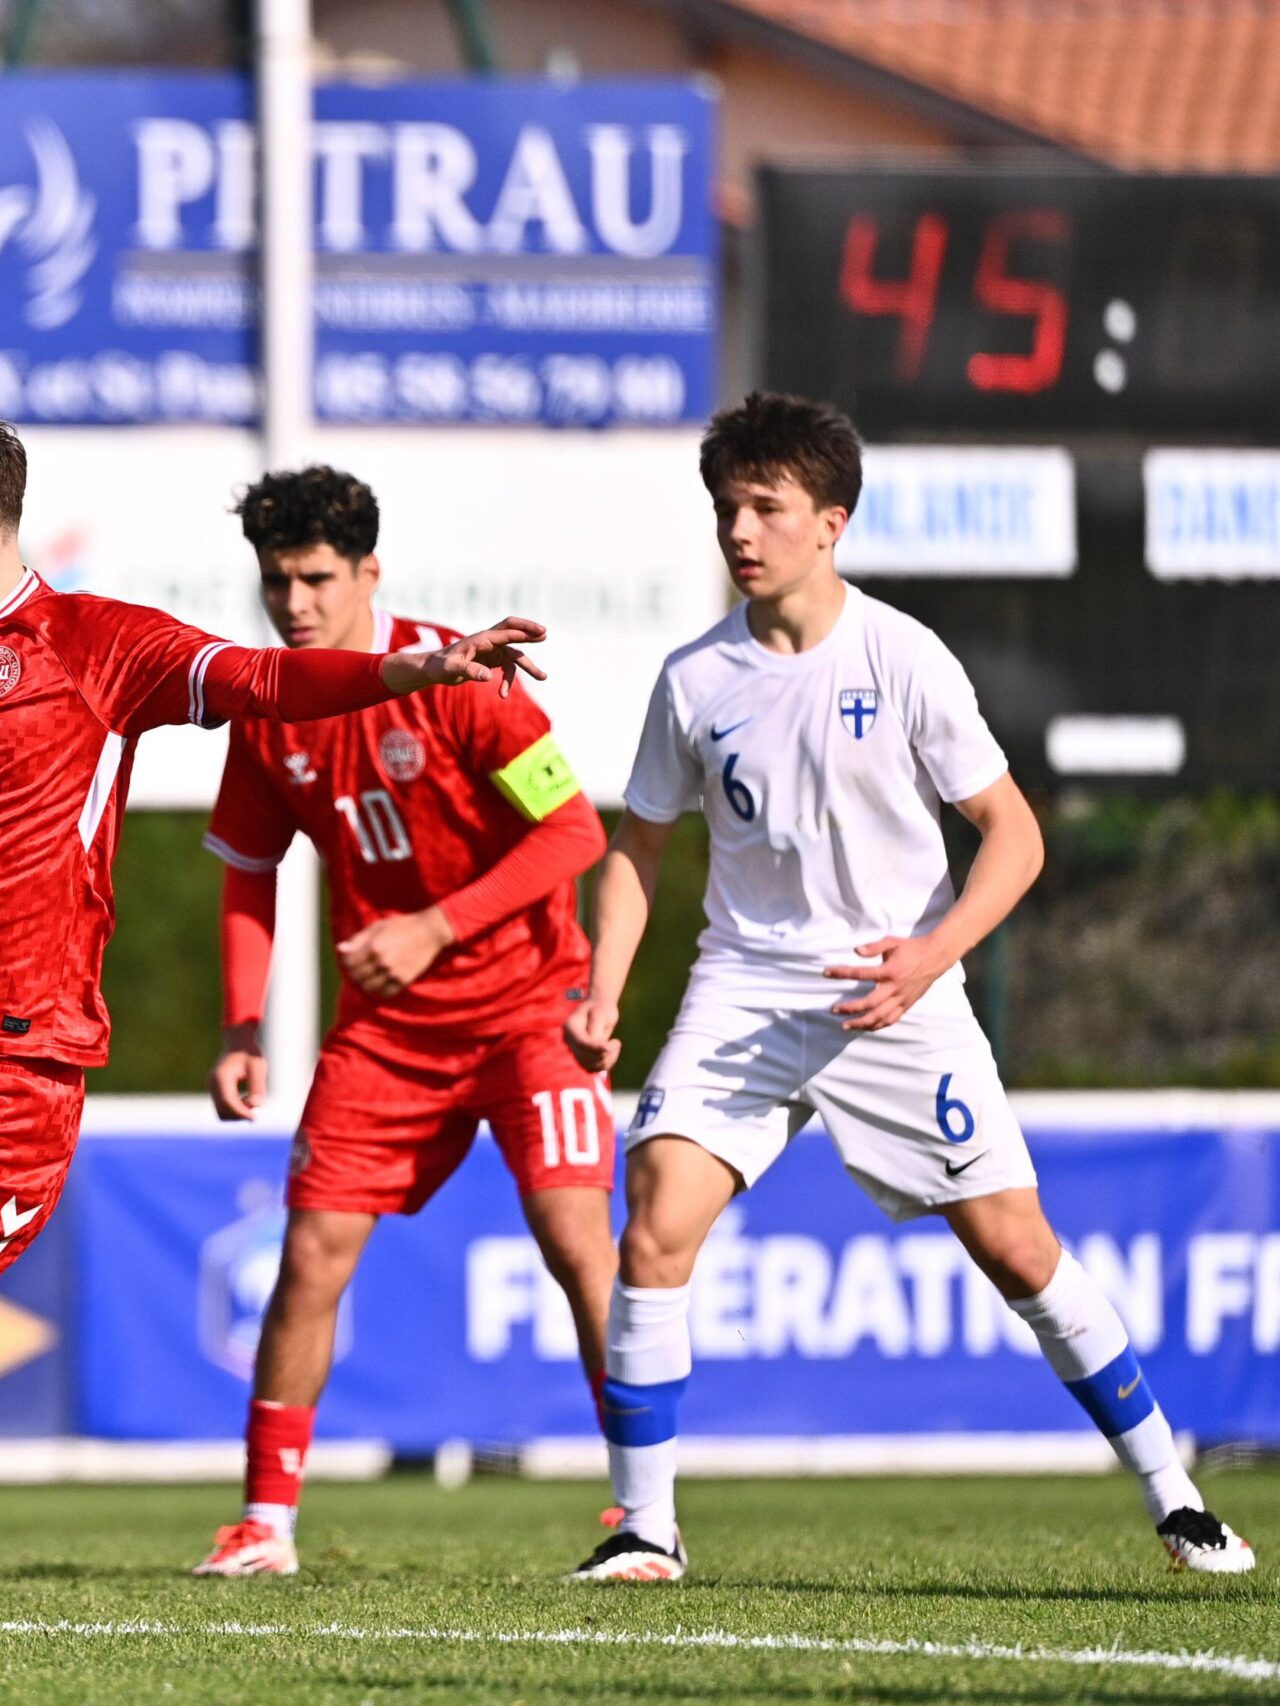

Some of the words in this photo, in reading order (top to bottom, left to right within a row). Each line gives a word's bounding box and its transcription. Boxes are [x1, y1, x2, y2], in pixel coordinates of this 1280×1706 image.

[723, 752, 755, 822] 6
[333, 787, 413, 864] 10
[531, 1087, 600, 1168] 10
[935, 1072, 975, 1144] 6
